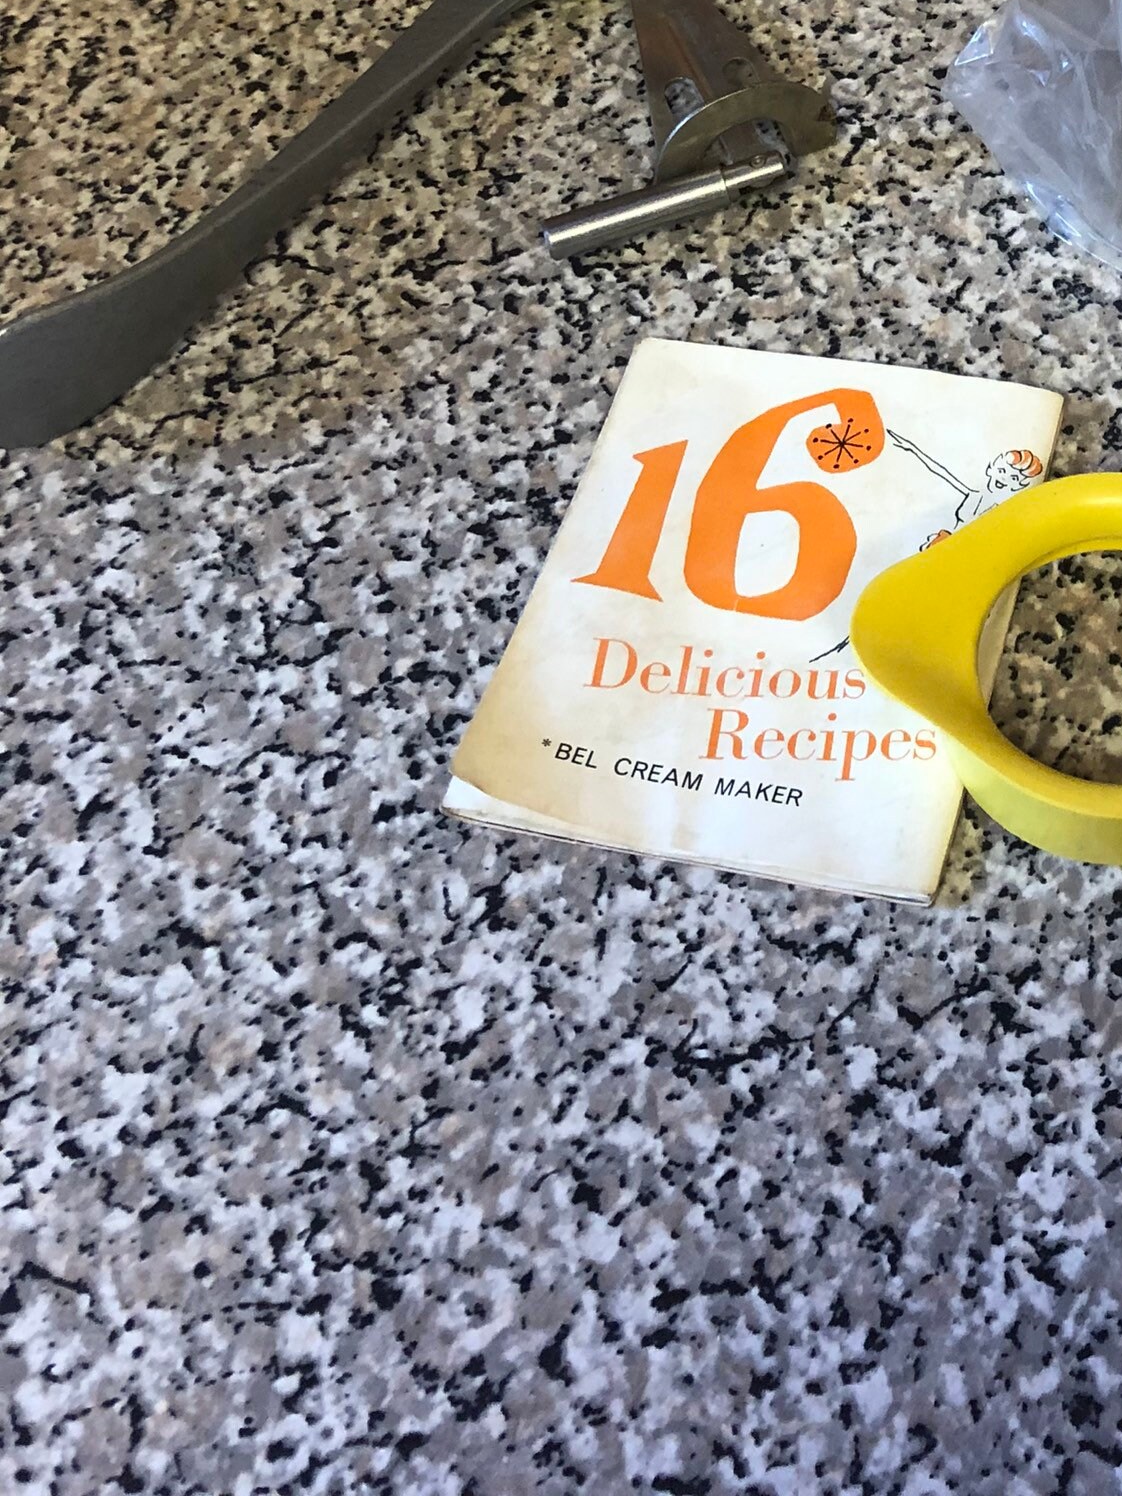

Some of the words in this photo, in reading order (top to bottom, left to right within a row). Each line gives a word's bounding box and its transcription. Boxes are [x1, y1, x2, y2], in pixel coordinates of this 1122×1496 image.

[570, 388, 885, 621] 16
[583, 638, 866, 700] Delicious
[699, 708, 938, 781] Recipes
[614, 758, 702, 791] CREAM
[714, 778, 803, 806] MAKER
